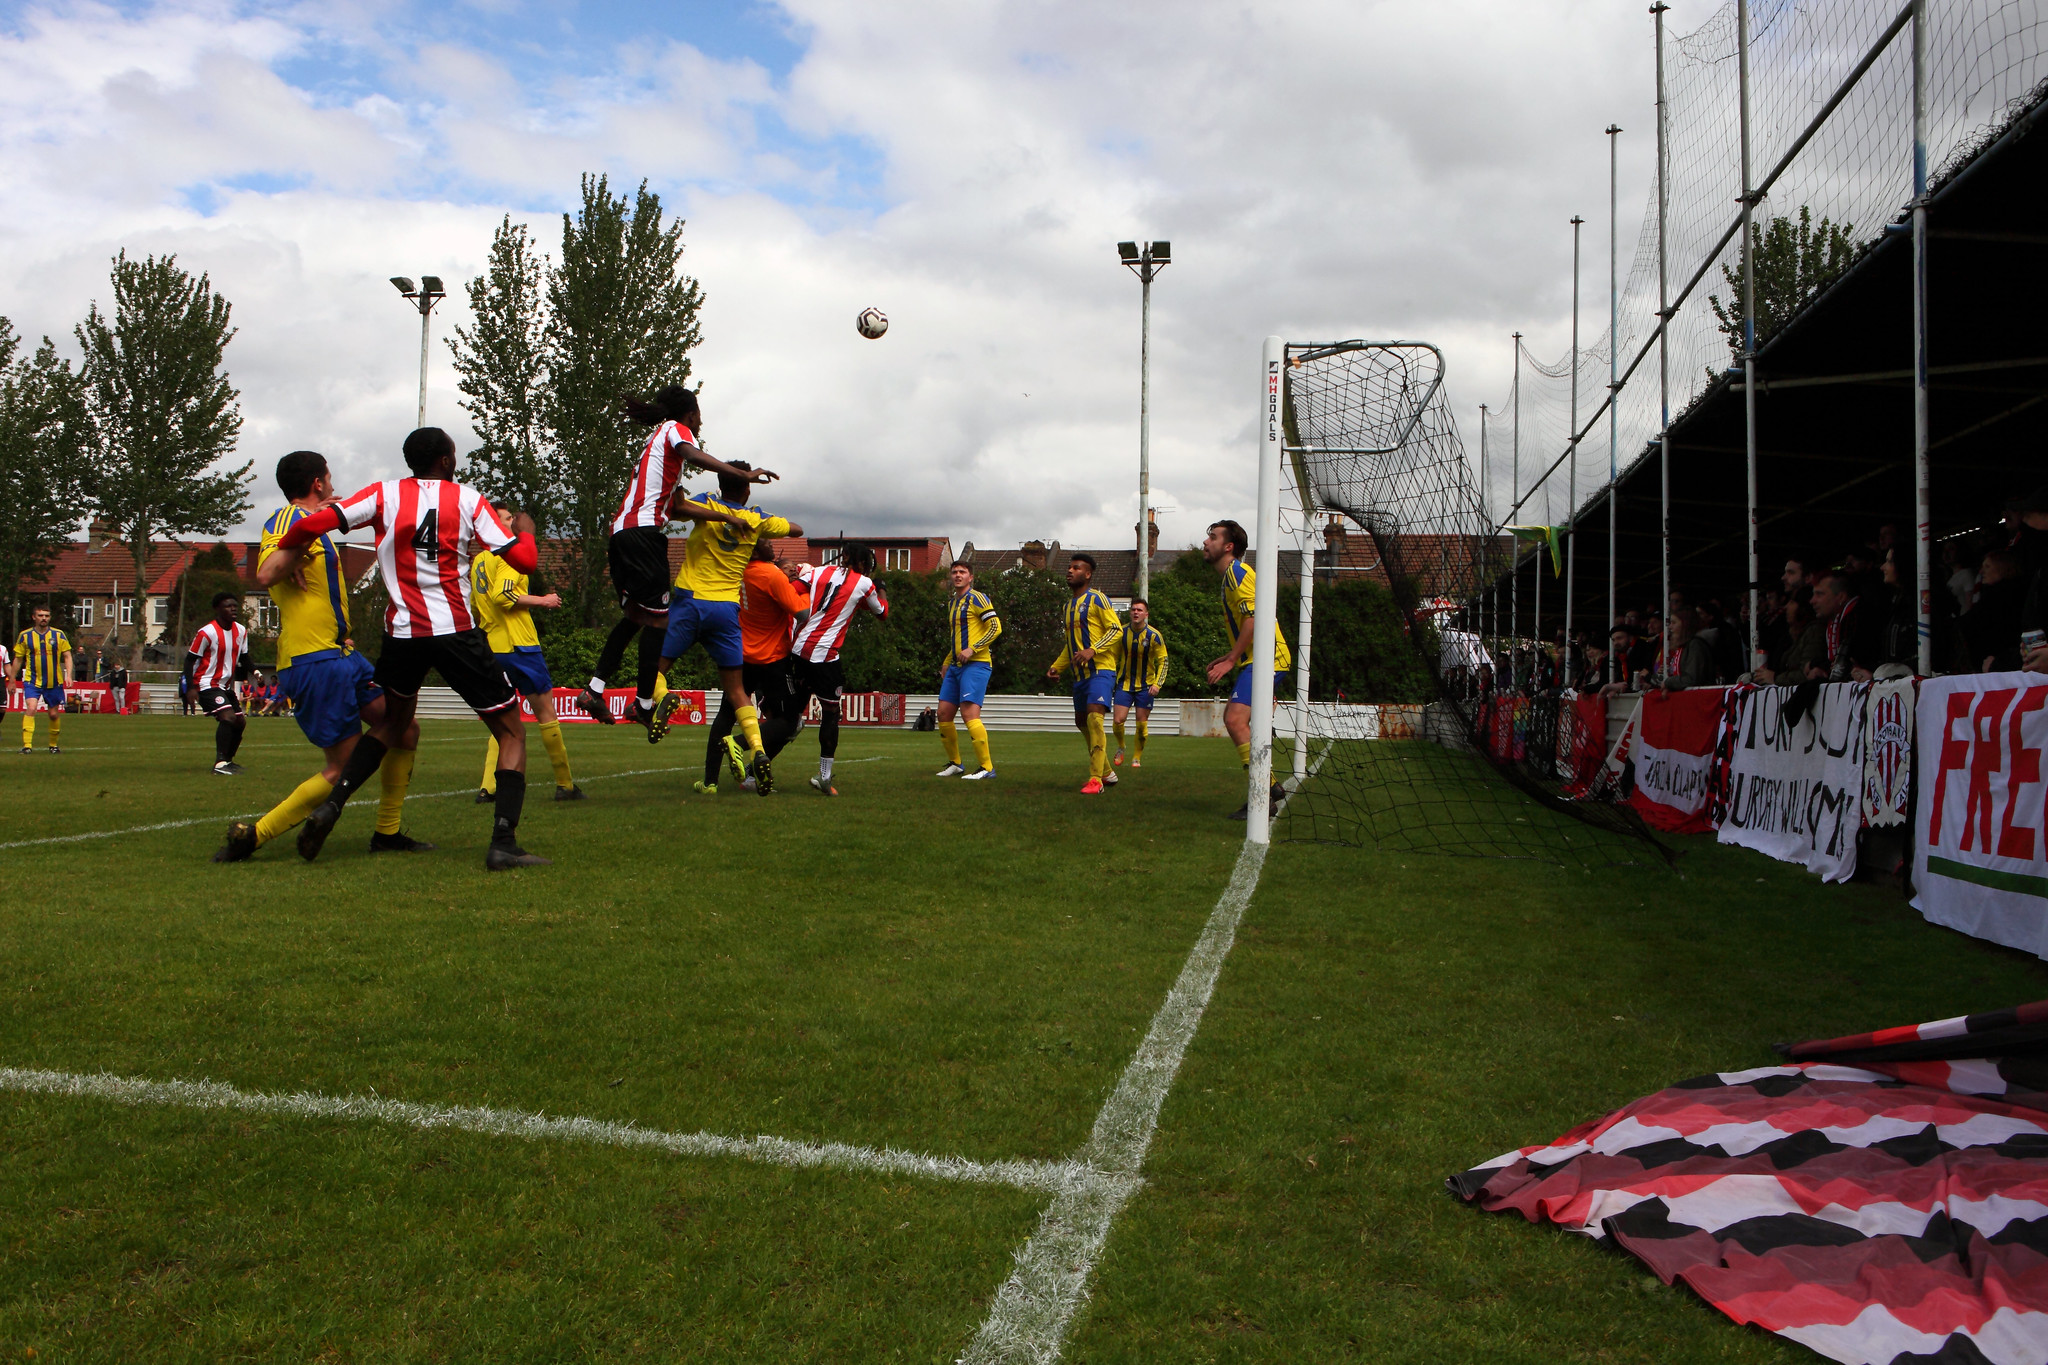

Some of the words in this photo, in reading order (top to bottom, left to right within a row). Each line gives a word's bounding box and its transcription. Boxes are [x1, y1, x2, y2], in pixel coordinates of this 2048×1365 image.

[411, 508, 440, 563] 4
[474, 561, 489, 595] 8
[816, 582, 842, 612] 11
[1929, 684, 2048, 862] FRE
